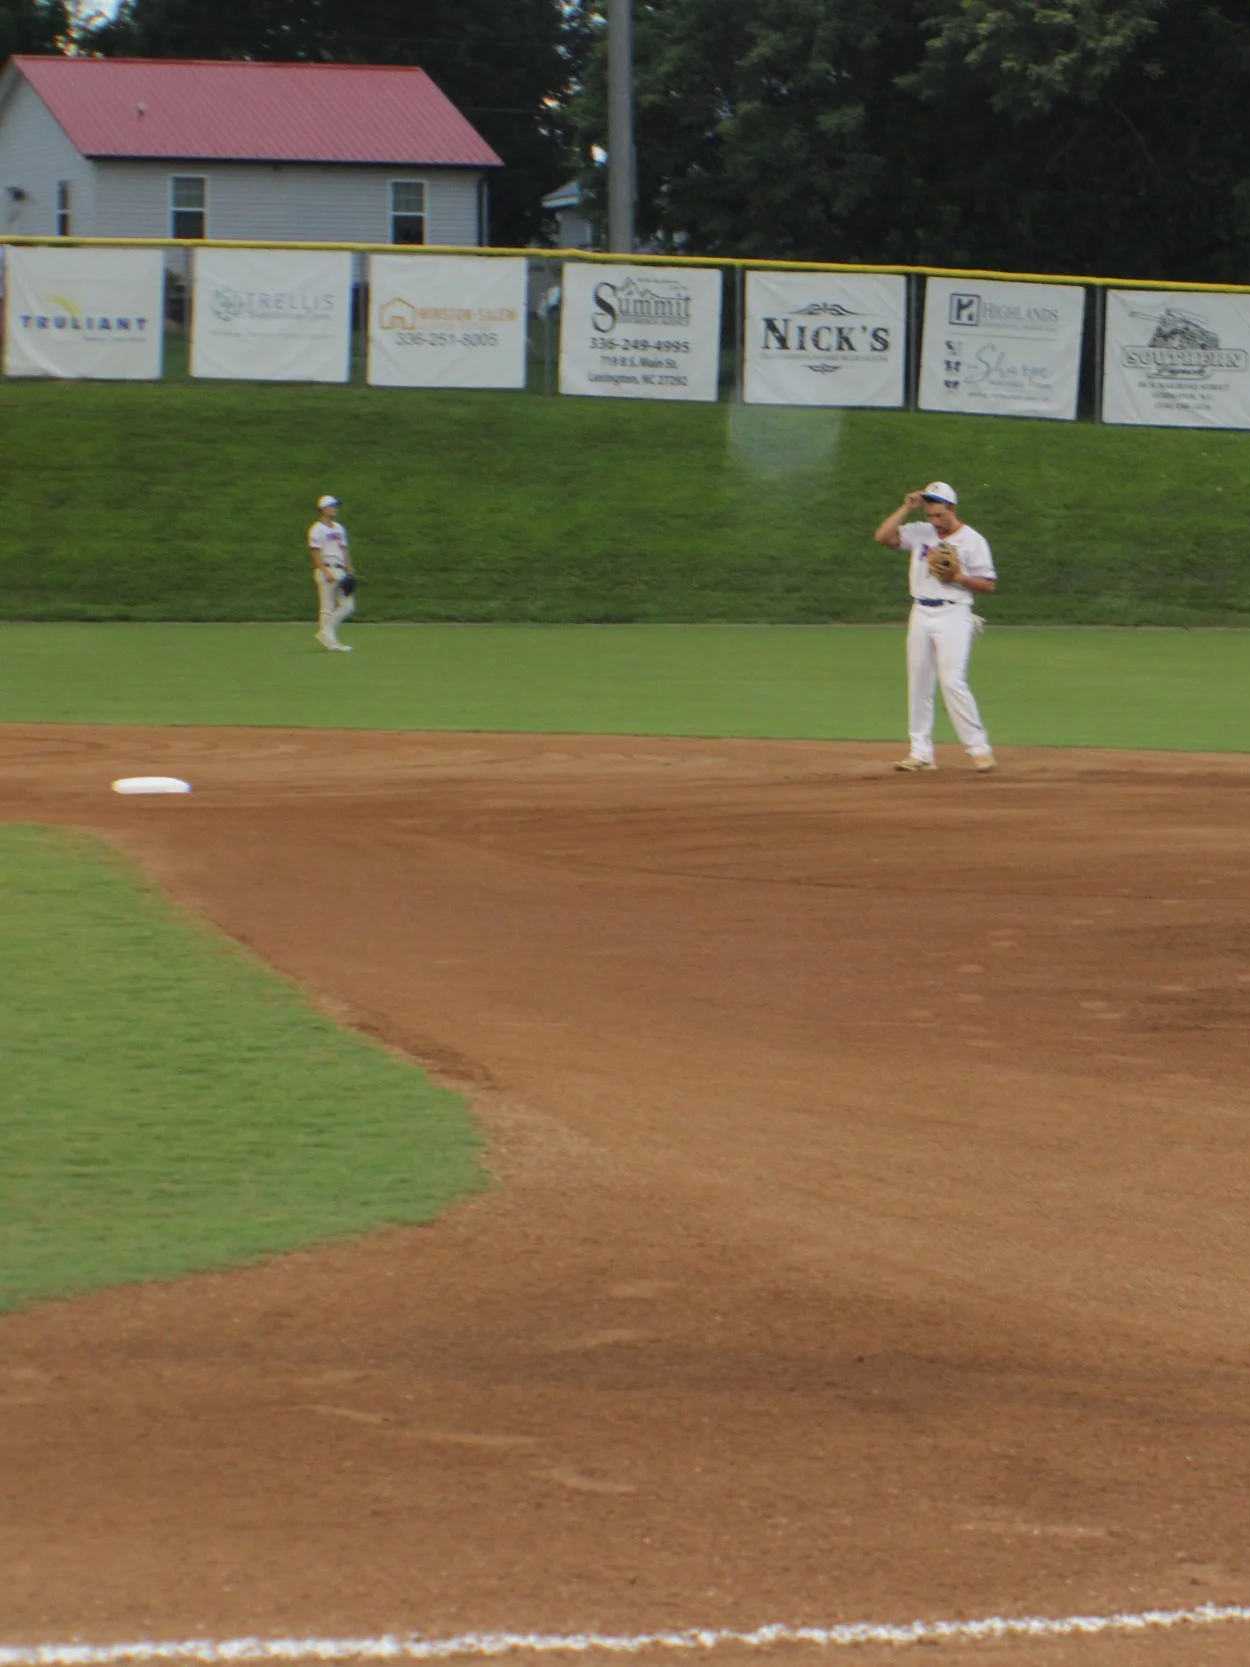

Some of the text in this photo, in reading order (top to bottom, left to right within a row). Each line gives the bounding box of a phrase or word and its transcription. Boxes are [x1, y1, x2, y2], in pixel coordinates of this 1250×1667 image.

[244, 291, 333, 311] TRELLIS
[591, 281, 692, 333] Summit
[981, 302, 1059, 322] HIGHLANDS
[19, 314, 148, 331] TRULIANT
[1125, 351, 1243, 369] SOUTHERN
